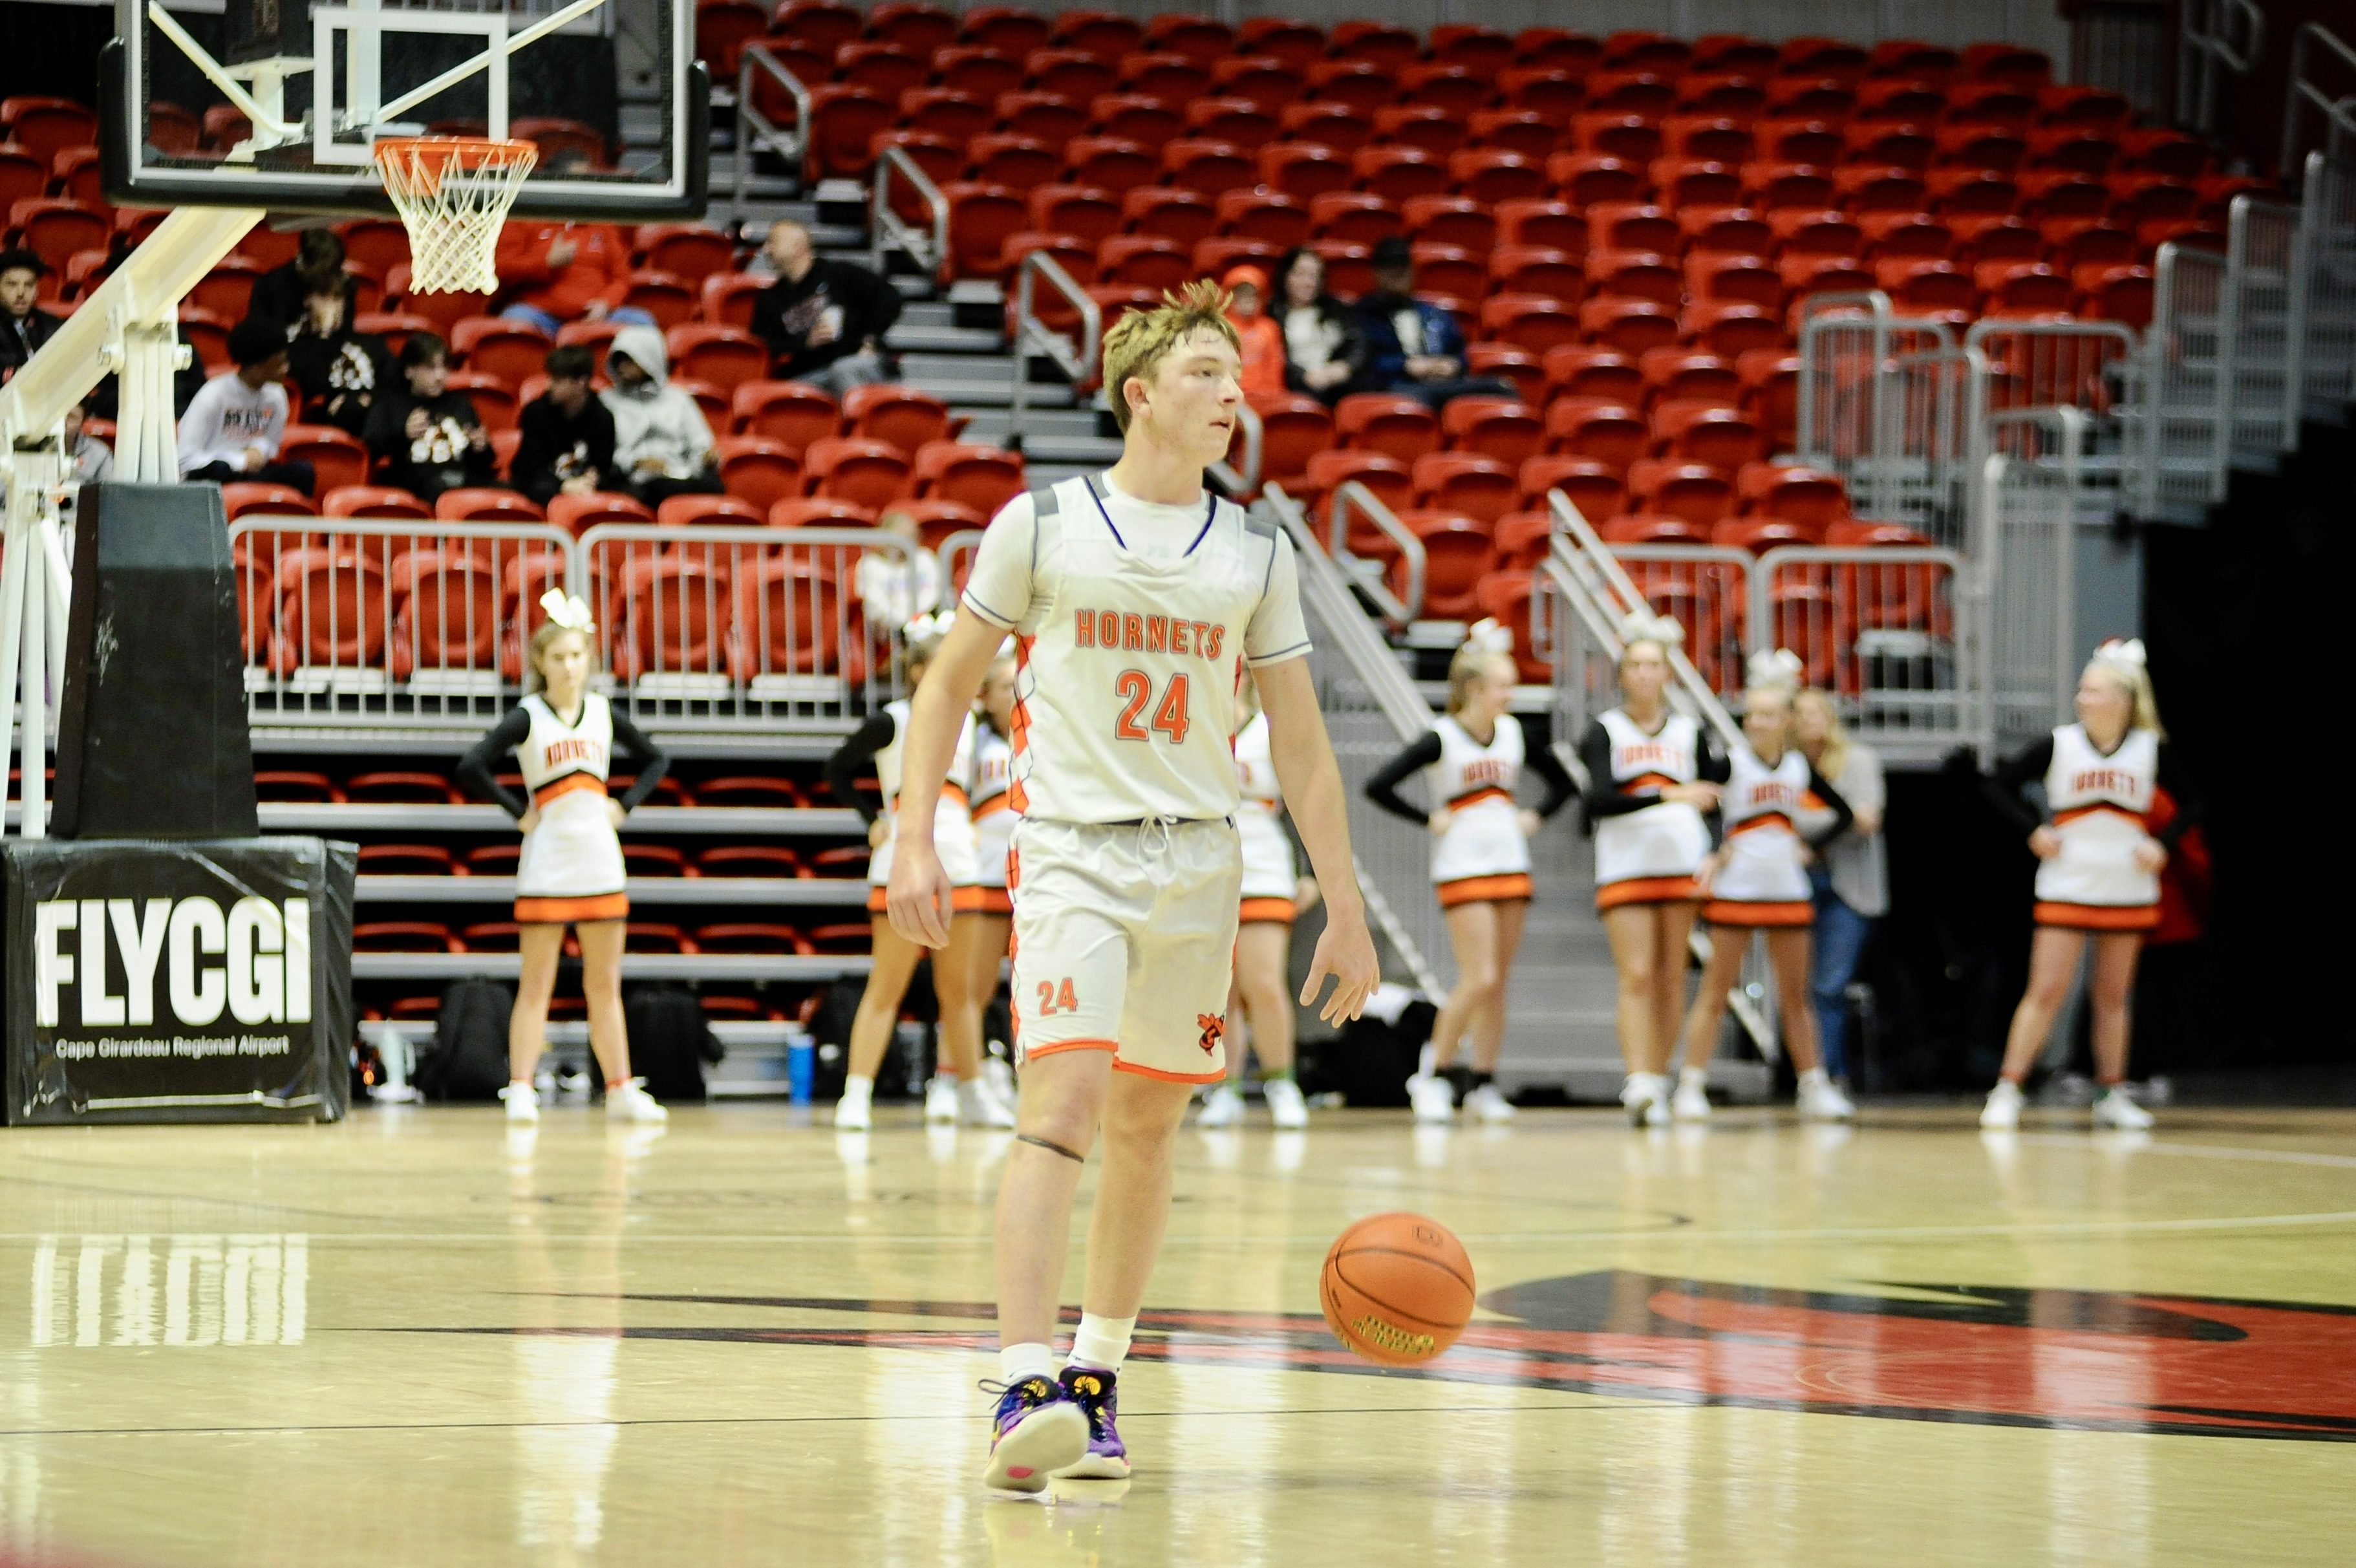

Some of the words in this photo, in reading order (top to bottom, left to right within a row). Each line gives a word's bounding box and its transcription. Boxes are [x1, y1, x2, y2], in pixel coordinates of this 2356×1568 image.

[1075, 609, 1225, 660] HORNETS
[1115, 669, 1190, 744] 24
[35, 896, 312, 1027] FLYCGI
[1036, 977, 1077, 1016] 24
[56, 1038, 96, 1062] Cape
[98, 1036, 170, 1058] Girardeau
[173, 1035, 236, 1060] Regional
[238, 1034, 290, 1058] Airport
